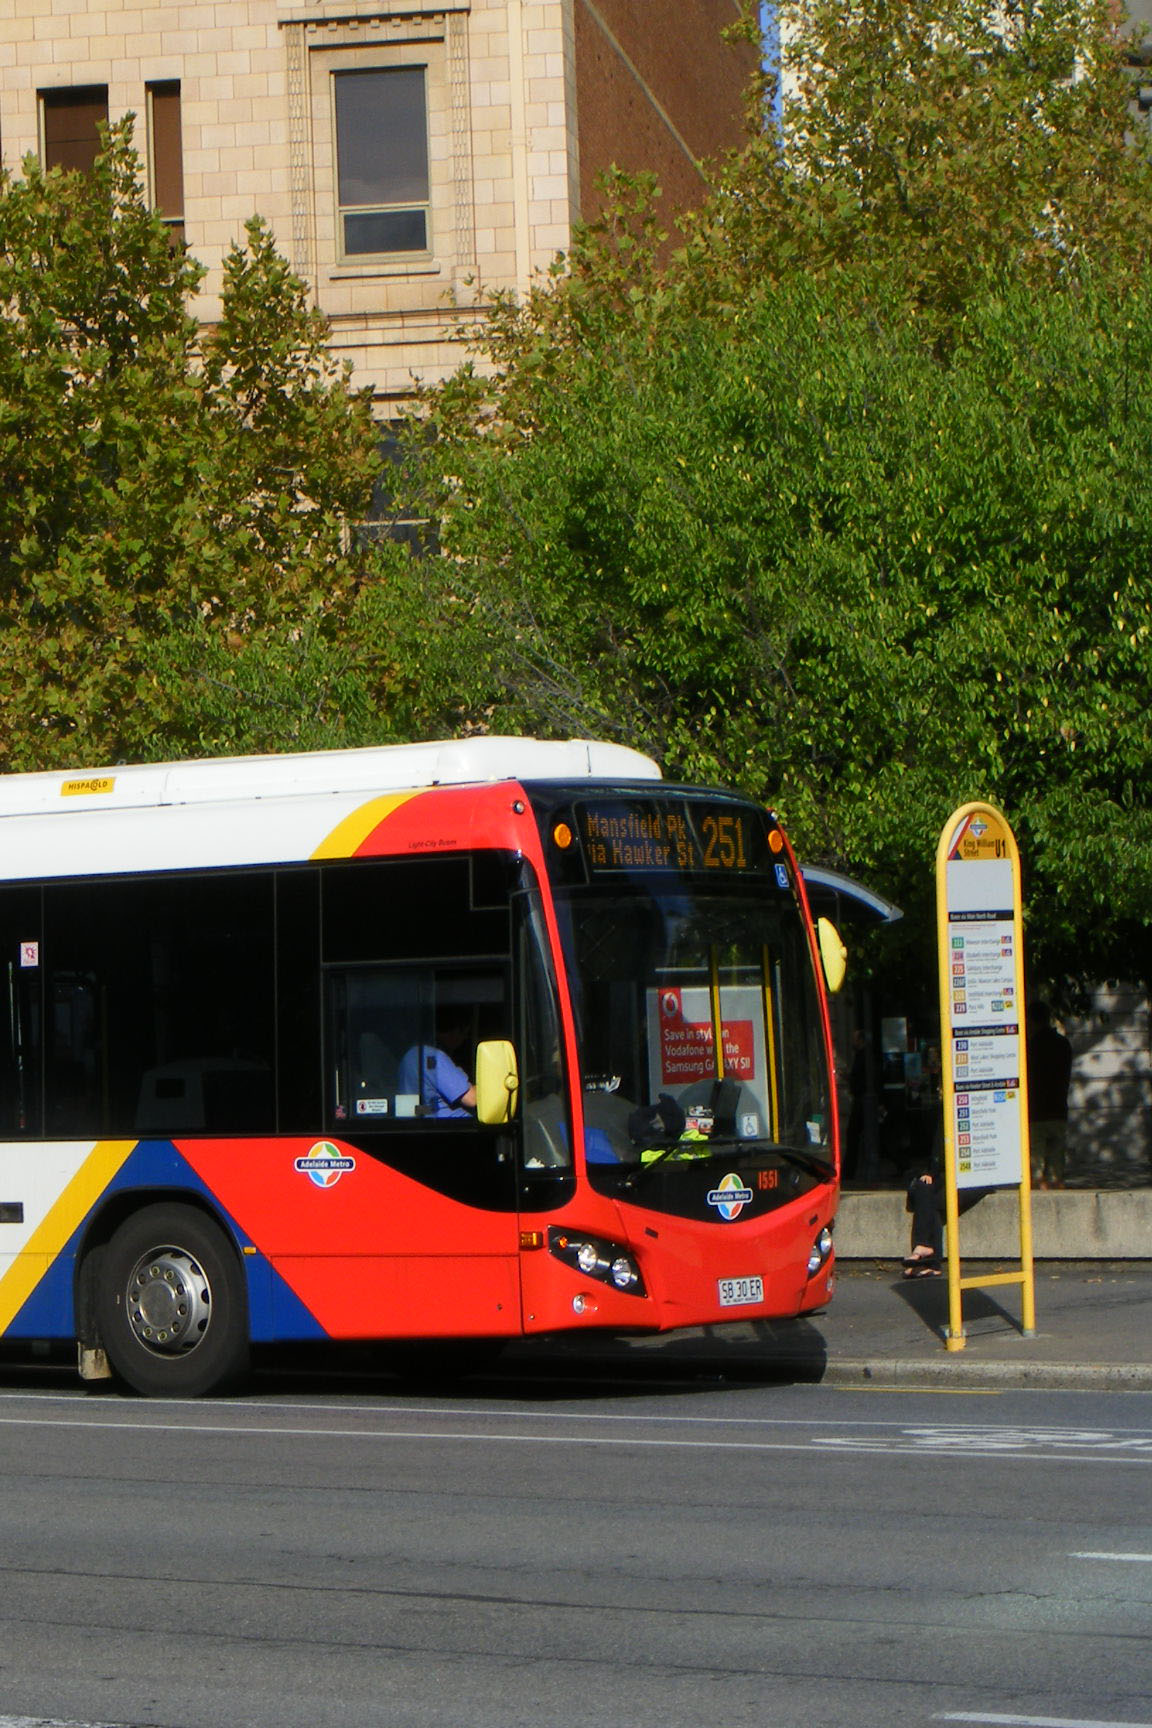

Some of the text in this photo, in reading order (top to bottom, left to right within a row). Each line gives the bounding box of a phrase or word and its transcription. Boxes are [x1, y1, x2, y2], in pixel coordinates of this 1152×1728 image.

[587, 813, 686, 840] Mansfield Pk
[702, 816, 747, 868] 251
[612, 839, 670, 865] Hawker
[677, 841, 694, 867] St
[664, 1028, 685, 1040] Save
[686, 1028, 695, 1039] in
[696, 1027, 713, 1042] styl
[665, 1044, 704, 1056] Vodafone
[725, 1042, 740, 1054] the
[666, 1061, 704, 1074] Samsung
[300, 1160, 350, 1168] Adelaide Metro
[758, 1170, 778, 1190] 1551
[712, 1191, 749, 1201] Adelaide Metro
[722, 1279, 762, 1299] SB 30 ER
